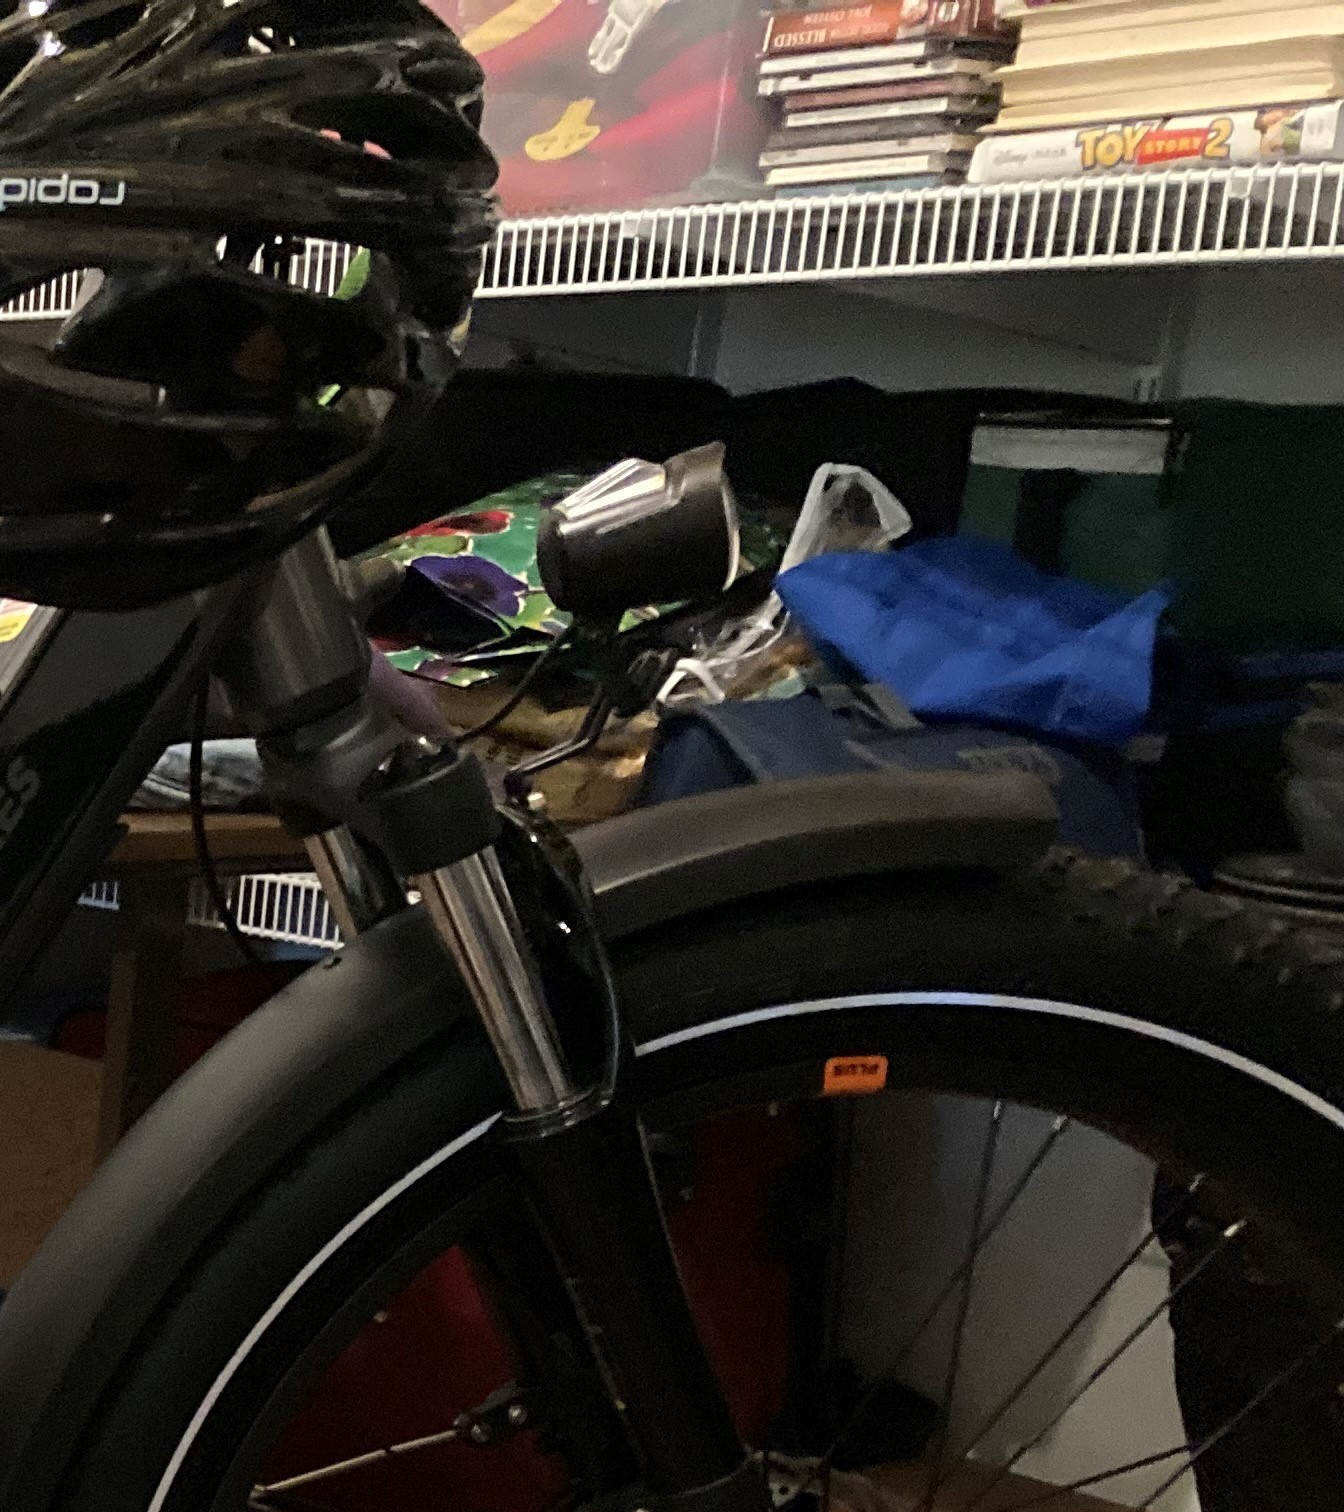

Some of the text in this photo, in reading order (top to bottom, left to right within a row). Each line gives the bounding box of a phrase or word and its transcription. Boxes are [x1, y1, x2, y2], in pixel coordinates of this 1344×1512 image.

[1076, 117, 1234, 170] TOY STORY 2
